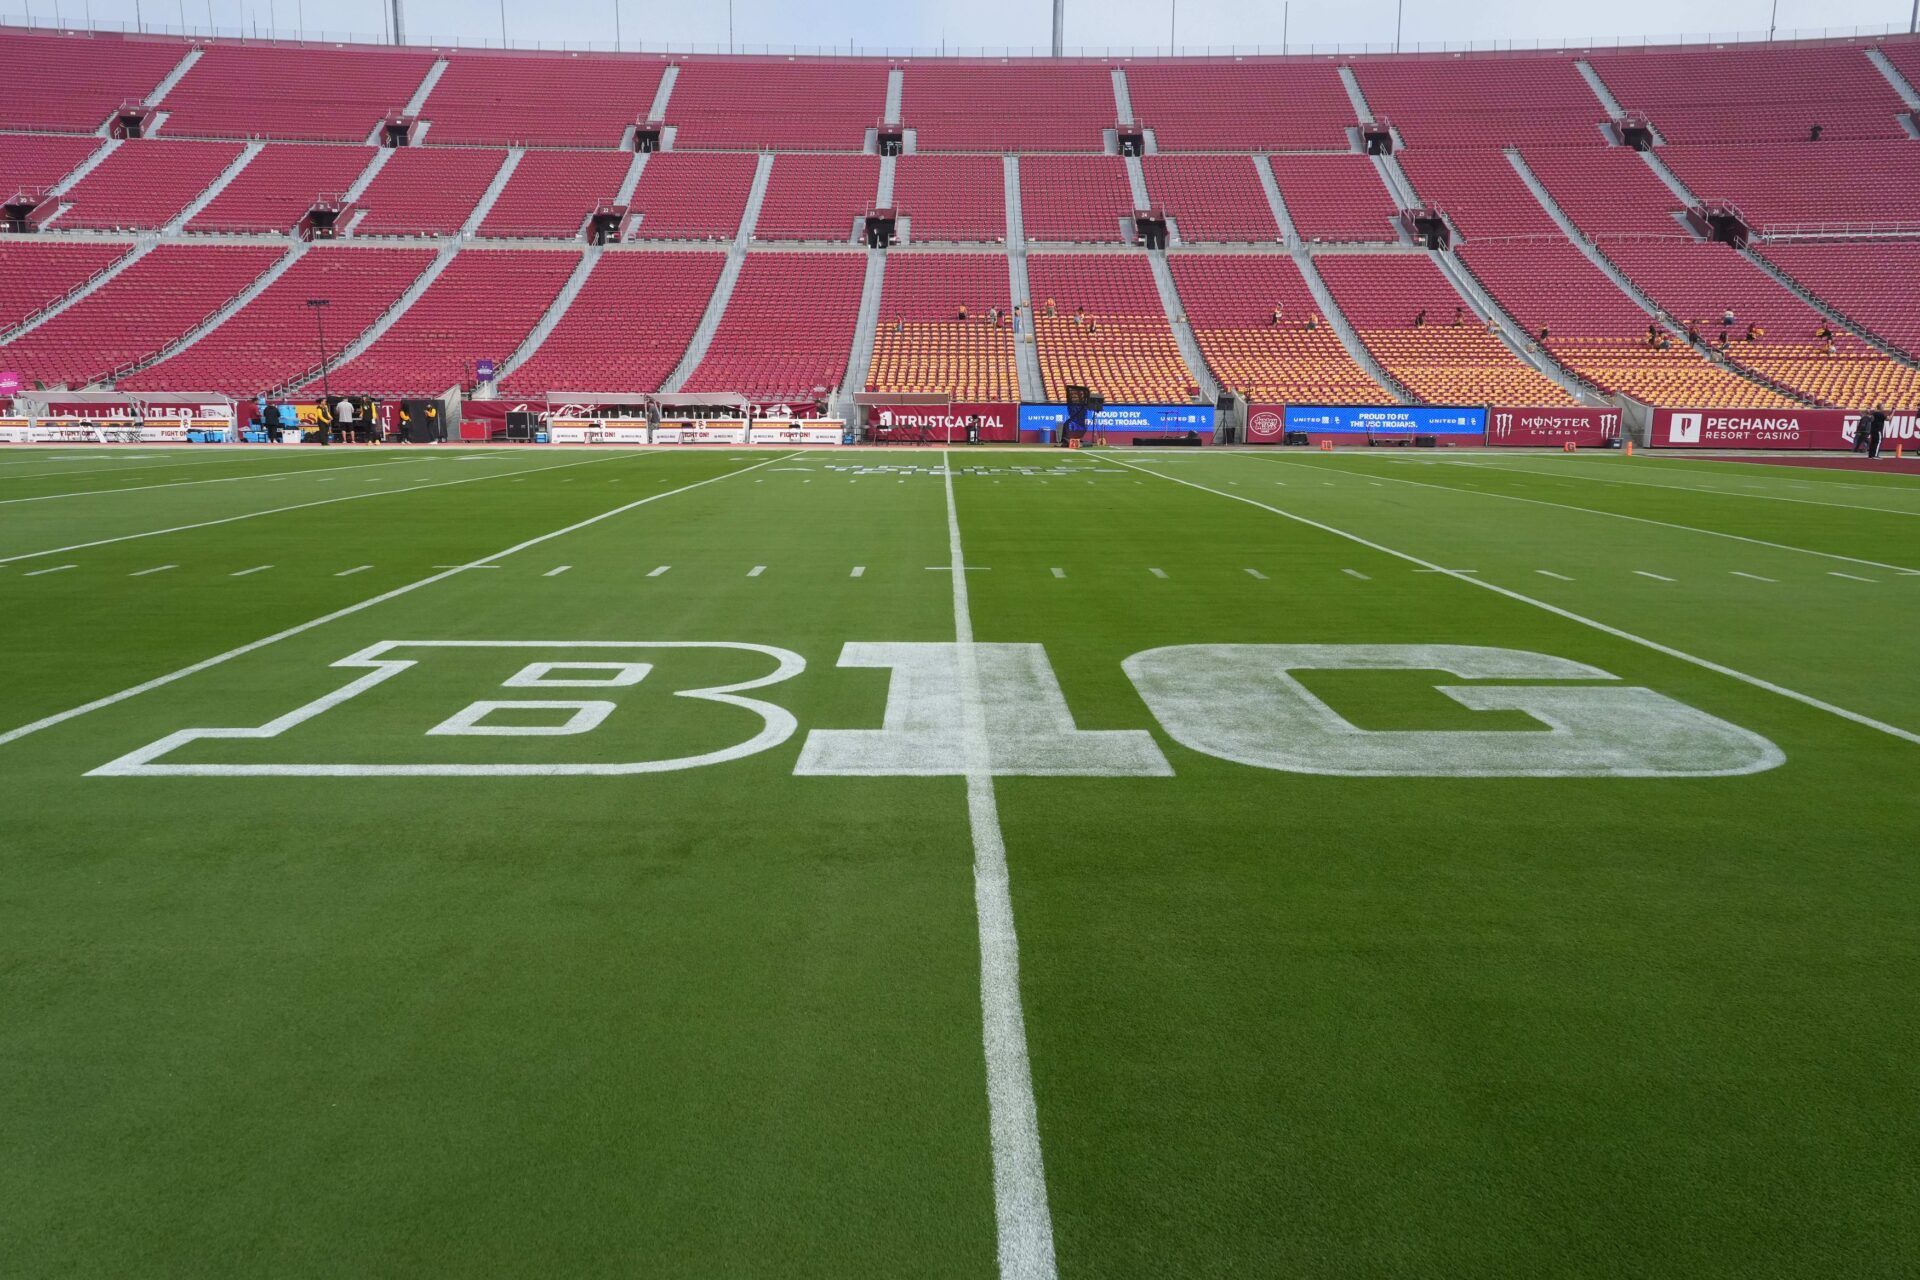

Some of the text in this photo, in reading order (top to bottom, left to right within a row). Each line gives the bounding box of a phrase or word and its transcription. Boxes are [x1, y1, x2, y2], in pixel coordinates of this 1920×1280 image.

[895, 415, 1004, 428] ITRUSTCAPTAL
[1521, 417, 1590, 428] MONSTER
[1706, 418, 1800, 430] PECHANGA
[1705, 431, 1800, 440] RESORT CASINO
